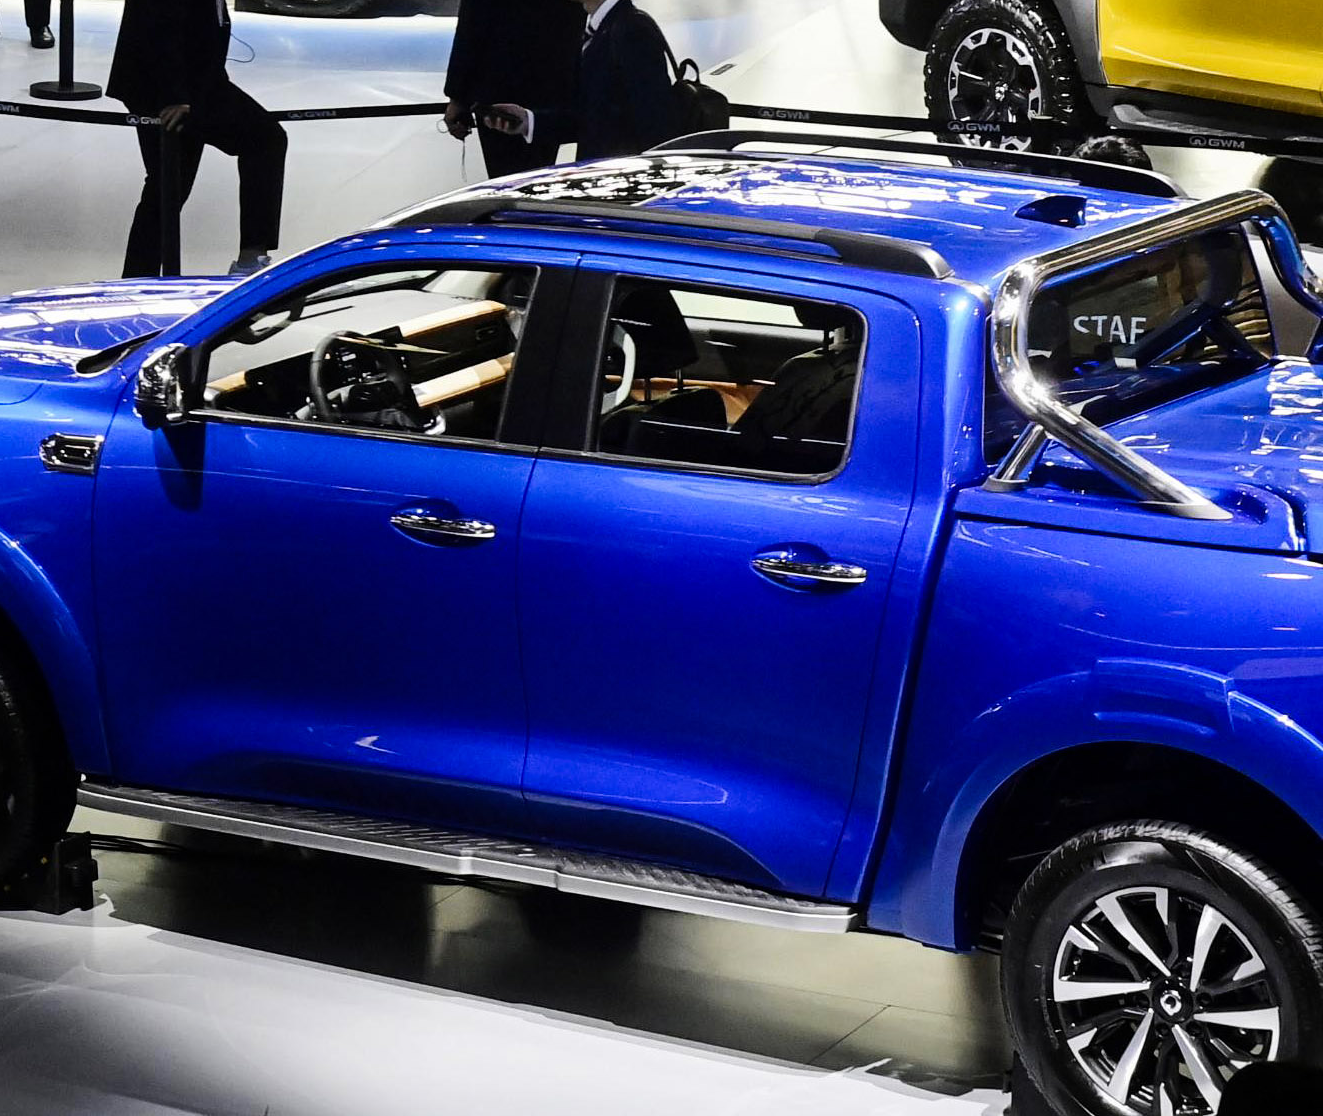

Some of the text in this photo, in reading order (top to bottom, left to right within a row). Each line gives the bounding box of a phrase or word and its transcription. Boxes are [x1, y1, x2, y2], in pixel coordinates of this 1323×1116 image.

[304, 111, 337, 119] GWM
[776, 110, 811, 121] GWM
[965, 123, 1001, 133] GWM
[1208, 137, 1246, 150] GWM
[1073, 315, 1148, 345] STAF
